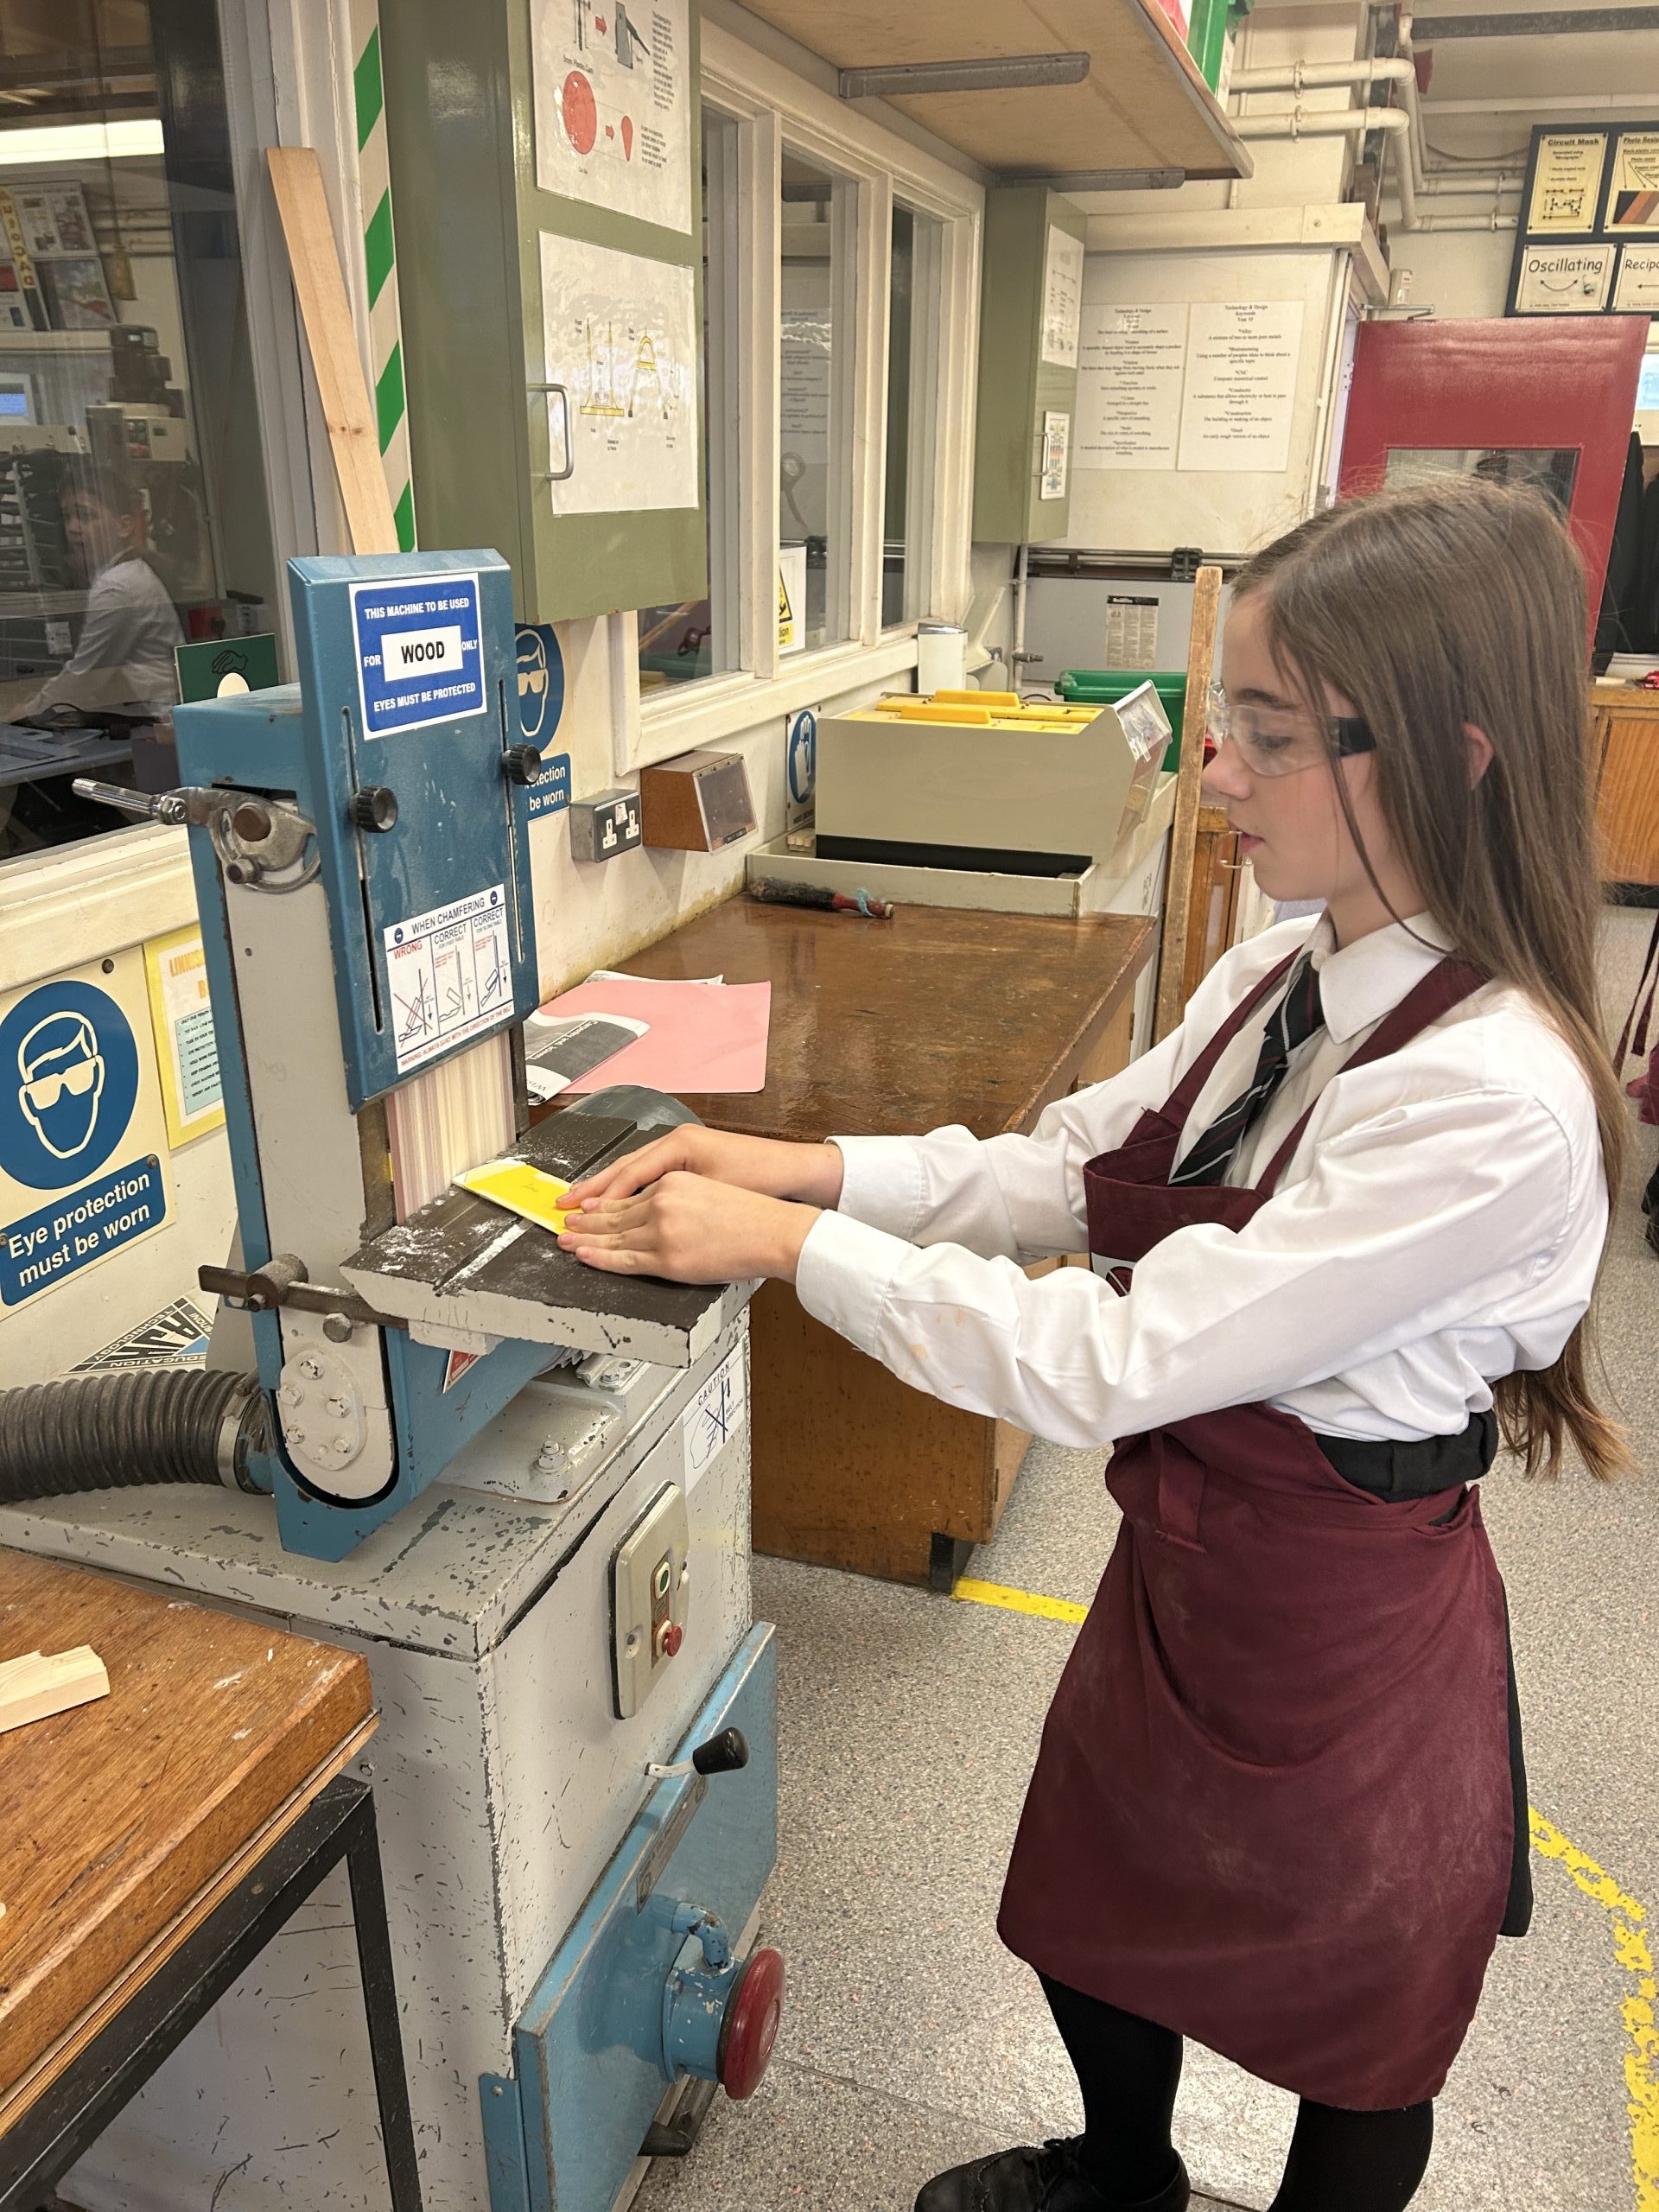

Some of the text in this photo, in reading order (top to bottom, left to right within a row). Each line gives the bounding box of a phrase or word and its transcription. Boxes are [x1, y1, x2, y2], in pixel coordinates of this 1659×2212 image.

[1529, 257, 1602, 274] Oscillating
[365, 597, 470, 620] THIS MACHINE TO BE USED
[364, 639, 478, 667] FOR WOOD ONLY
[373, 682, 475, 712] EYES MUST BE PROTECTED
[529, 789, 564, 810] be worn
[411, 897, 485, 935] WHEN CHAMFERING
[393, 940, 423, 960] WRONG
[434, 924, 467, 944] CORRECT
[474, 908, 503, 927] CORRECT
[168, 948, 207, 978] LINNIS
[8, 1173, 150, 1259] Eye protection
[19, 1205, 150, 1287] must be worn
[94, 1310, 173, 1361] TECHNOLOGY
[110, 1355, 207, 1368] EDUCATION
[698, 1361, 729, 1405] CAUTION
